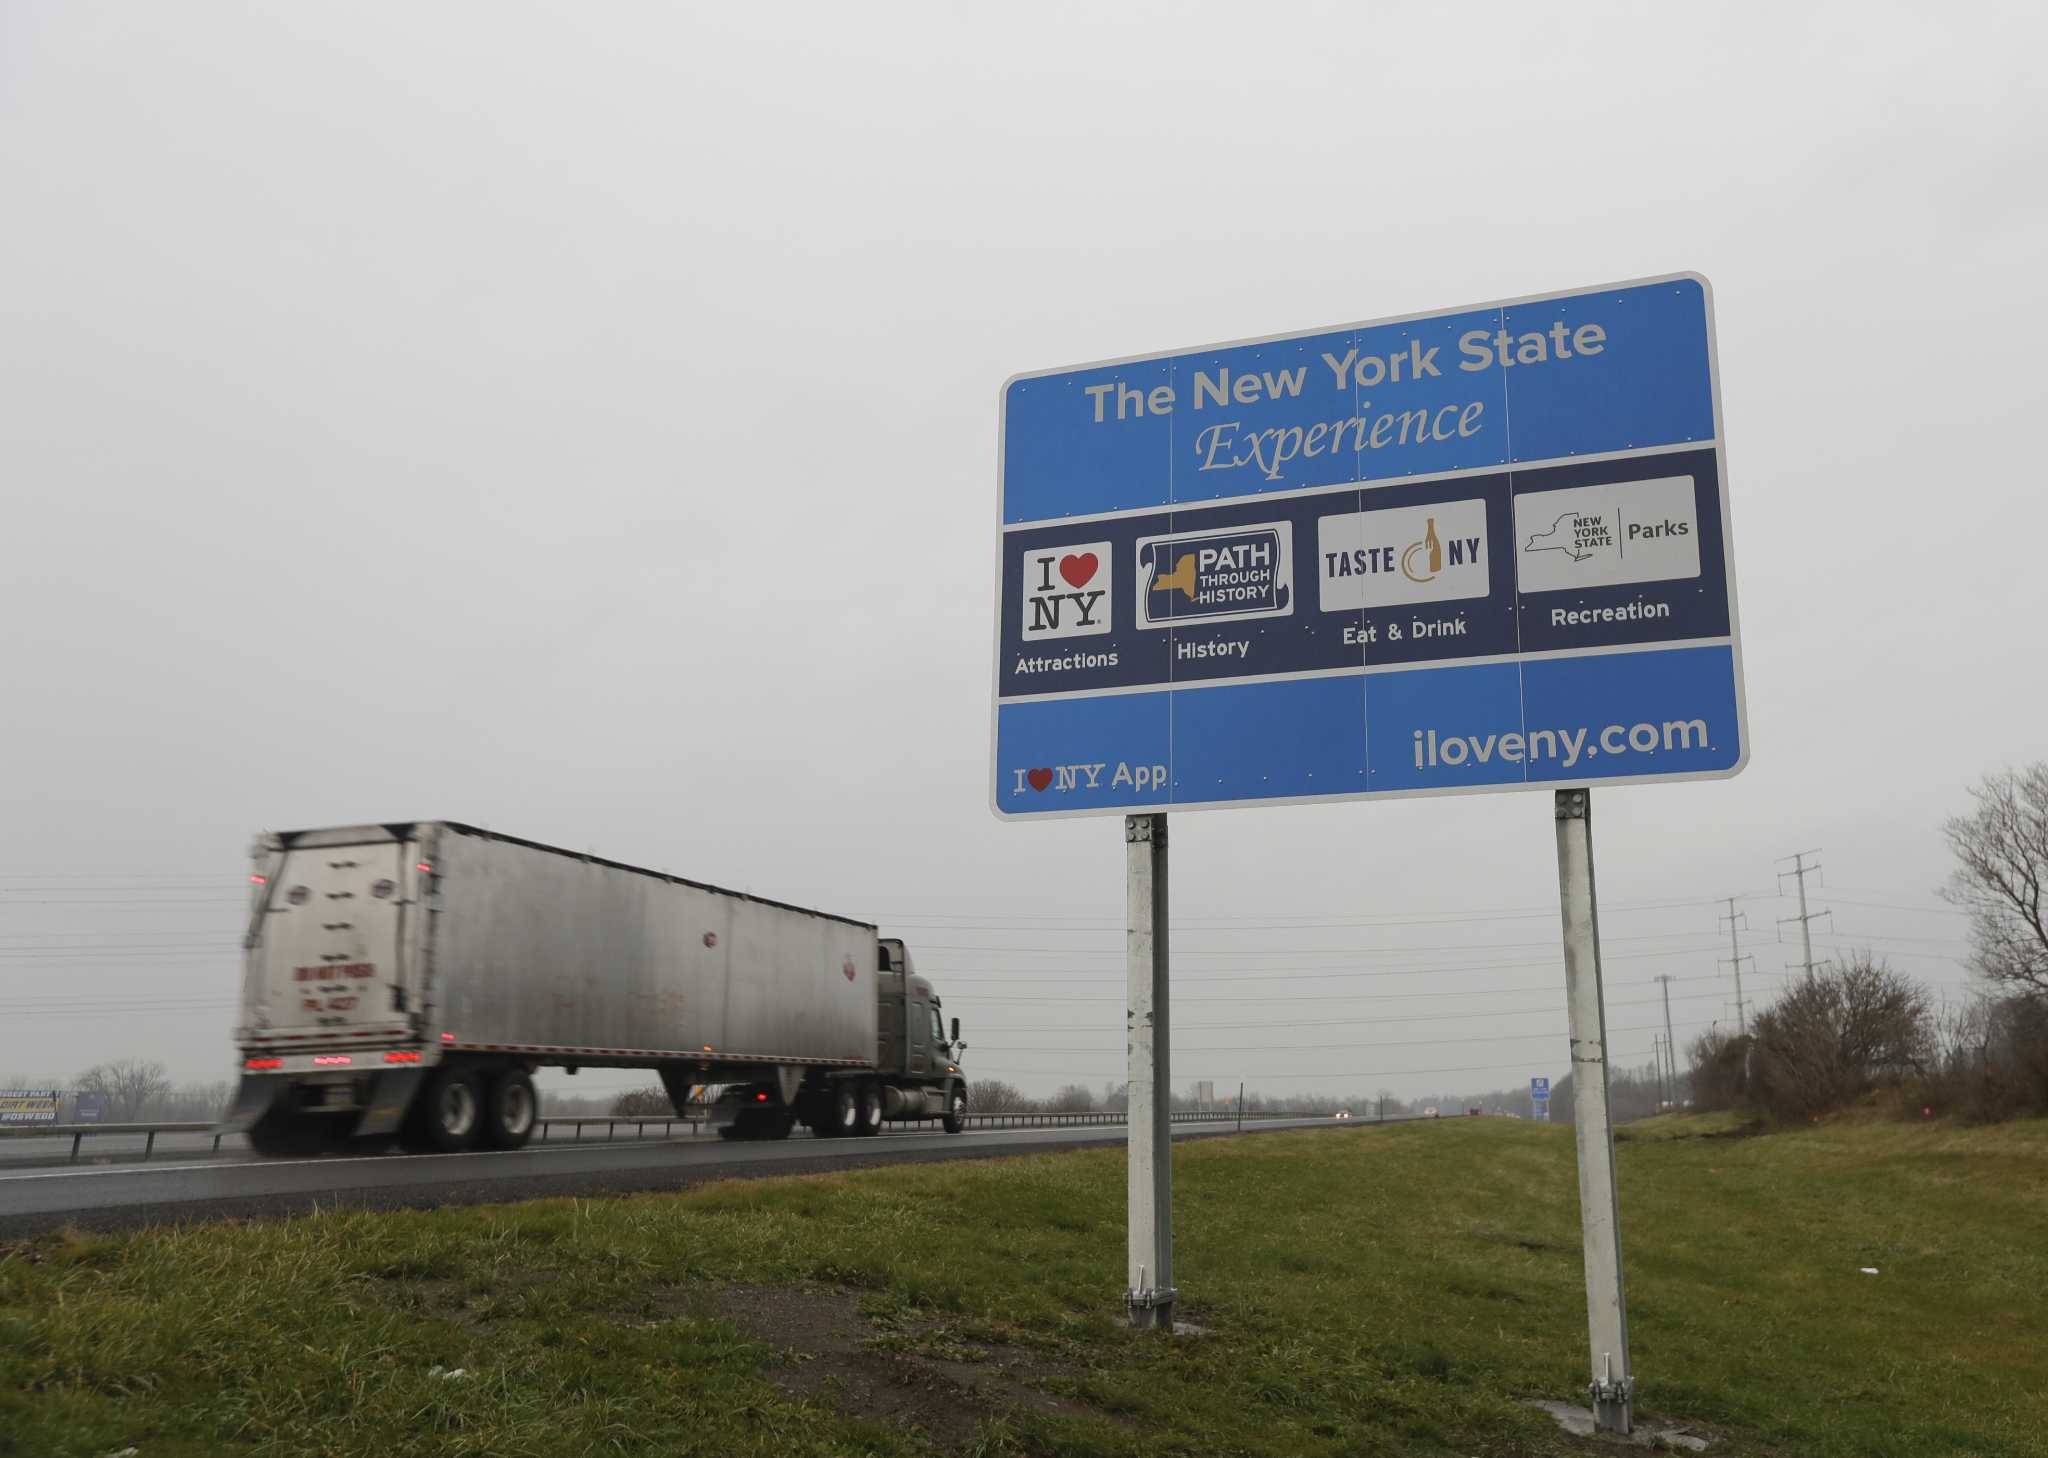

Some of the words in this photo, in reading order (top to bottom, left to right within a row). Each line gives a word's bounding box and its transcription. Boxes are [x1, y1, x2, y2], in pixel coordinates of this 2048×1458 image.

[1084, 383, 1176, 424] The
[1194, 363, 1308, 411] New
[1321, 339, 1442, 391] York
[1458, 321, 1608, 373] State
[1195, 401, 1484, 480] Experience
[1573, 516, 1602, 527] NEW
[1573, 526, 1609, 538] YORK
[1628, 519, 1689, 540] Parks
[1574, 536, 1613, 549] STATE
[1199, 542, 1271, 573] PATH
[1325, 546, 1396, 578] TASTE
[1448, 537, 1481, 566] NY
[1037, 557, 1056, 591] I
[1199, 568, 1271, 588] THROUGH
[1199, 584, 1271, 605] HISTORY
[1028, 590, 1106, 631] NY
[1550, 602, 1671, 627] Recreation
[1342, 625, 1377, 646] Eat
[1387, 624, 1404, 640] &
[1413, 618, 1467, 640] Drink
[1015, 651, 1120, 674] Attractions
[1176, 641, 1251, 660] History
[1413, 719, 1708, 768] iloveny.com
[1013, 768, 1026, 792] I
[1055, 763, 1106, 790] NY
[1111, 761, 1168, 793] App
